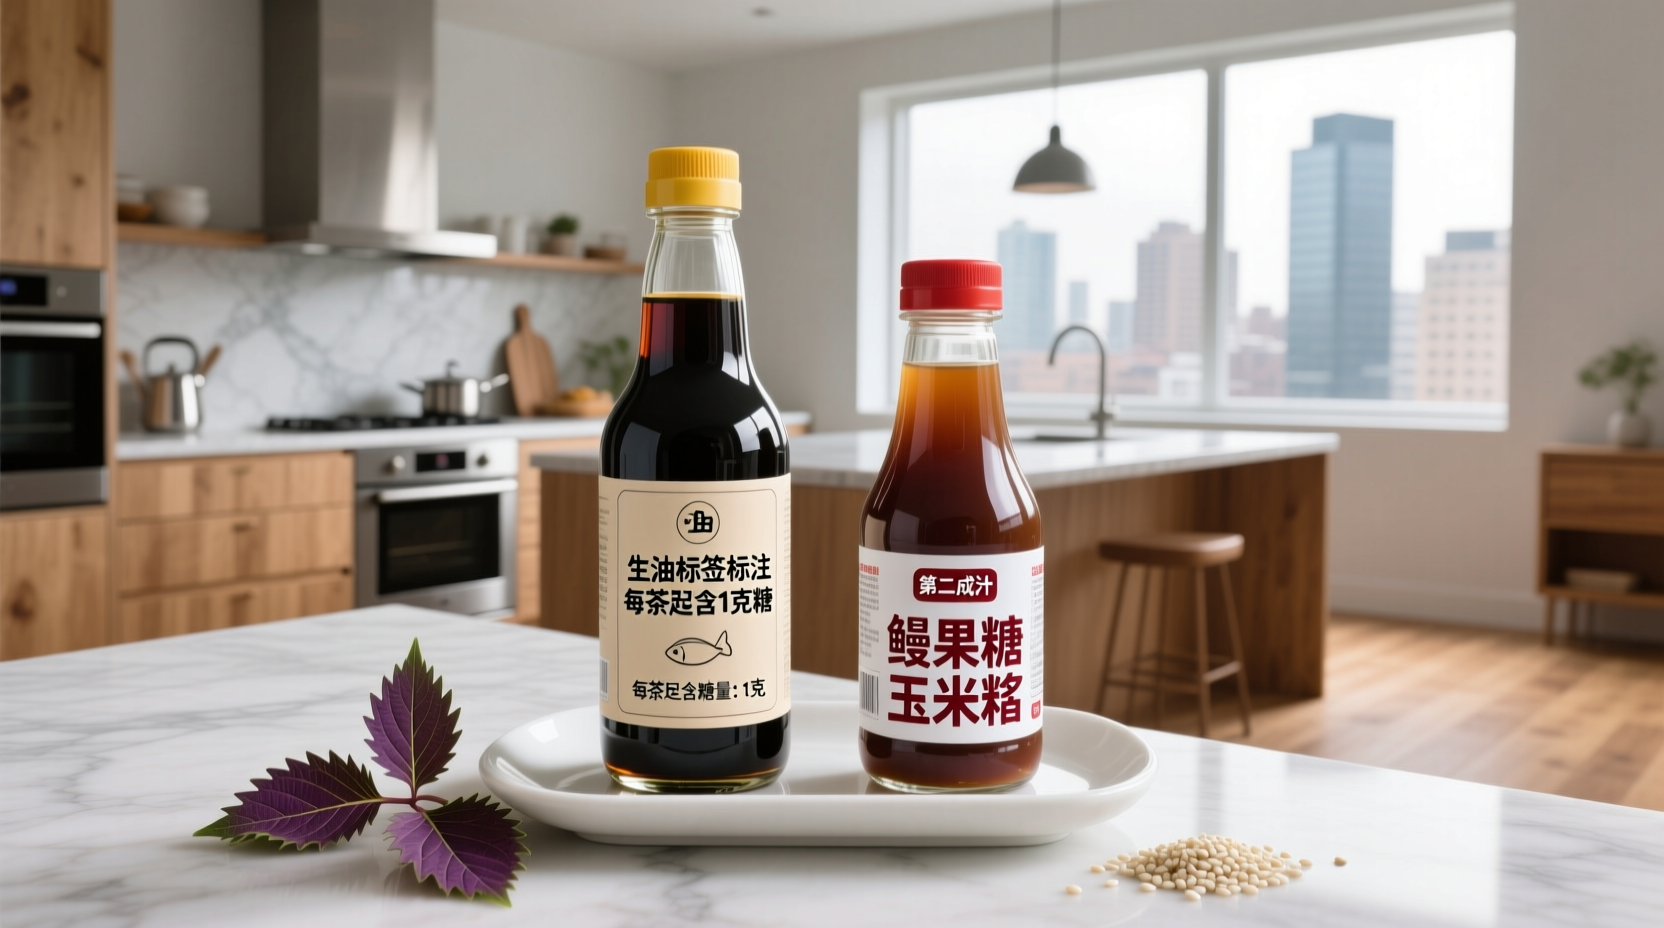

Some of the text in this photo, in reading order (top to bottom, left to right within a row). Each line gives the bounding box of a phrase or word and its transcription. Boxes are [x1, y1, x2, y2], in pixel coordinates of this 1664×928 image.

[627, 553, 772, 583] 生油标签标注
[887, 613, 1024, 670] 鳗果糖
